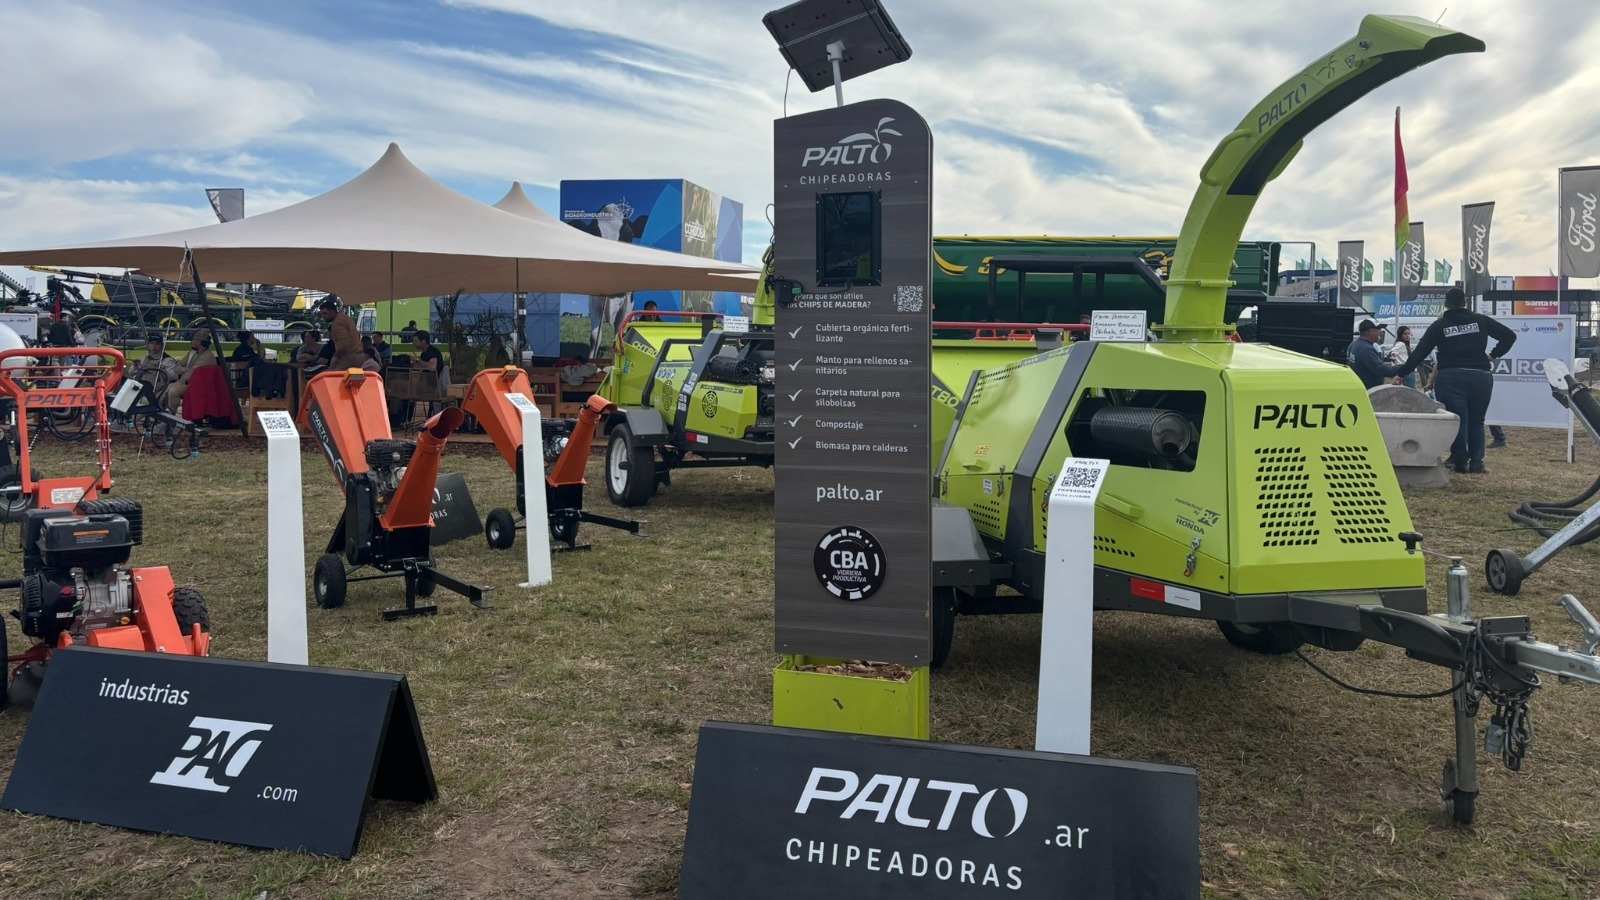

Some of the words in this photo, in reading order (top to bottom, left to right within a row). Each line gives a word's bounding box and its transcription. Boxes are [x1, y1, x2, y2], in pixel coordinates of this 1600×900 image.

[1257, 83, 1307, 133] PALTO
[801, 143, 892, 167] PALTO
[800, 171, 892, 185] CHIPEADORAS
[1568, 192, 1597, 252] Ford
[1467, 223, 1487, 274] Ford
[1401, 240, 1421, 284] Ford
[1343, 256, 1360, 293] Ford
[843, 292, 864, 300] útiles
[835, 301, 872, 309] MADERA?
[1379, 304, 1410, 316] GRAIAS
[1411, 304, 1428, 316] POR
[1428, 304, 1440, 316] SU
[816, 324, 851, 332] Cubierta
[853, 323, 889, 333] orgánica
[890, 324, 913, 332] ferti-
[1444, 327, 1457, 335] DA
[816, 334, 844, 342] lizante
[816, 356, 842, 364] Manto
[843, 358, 862, 366] para
[864, 356, 897, 365] rellenos
[1518, 360, 1546, 373] RO
[816, 366, 847, 374] nitarios
[24, 393, 97, 406] PALTO
[816, 388, 847, 398] Carpeta
[850, 389, 880, 397] natural
[881, 391, 900, 399] para
[932, 384, 959, 408] T80
[816, 399, 856, 407] silobolsas
[1253, 403, 1358, 429] PALTO
[312, 410, 329, 443] PALTO
[816, 420, 864, 430] Compostaje
[816, 441, 850, 450] Biomasa
[852, 443, 870, 452] para
[872, 442, 908, 452] calderas
[816, 483, 883, 502] palto.ar
[1176, 518, 1205, 534] HONDA
[830, 550, 869, 570] CBA
[832, 575, 867, 583] PRODUCTIVA
[99, 677, 190, 706] industrias
[256, 783, 298, 802] .com
[795, 767, 1028, 838] PALTO
[1044, 824, 1089, 849] .ar
[786, 838, 1023, 891] CHIPEADORAS
